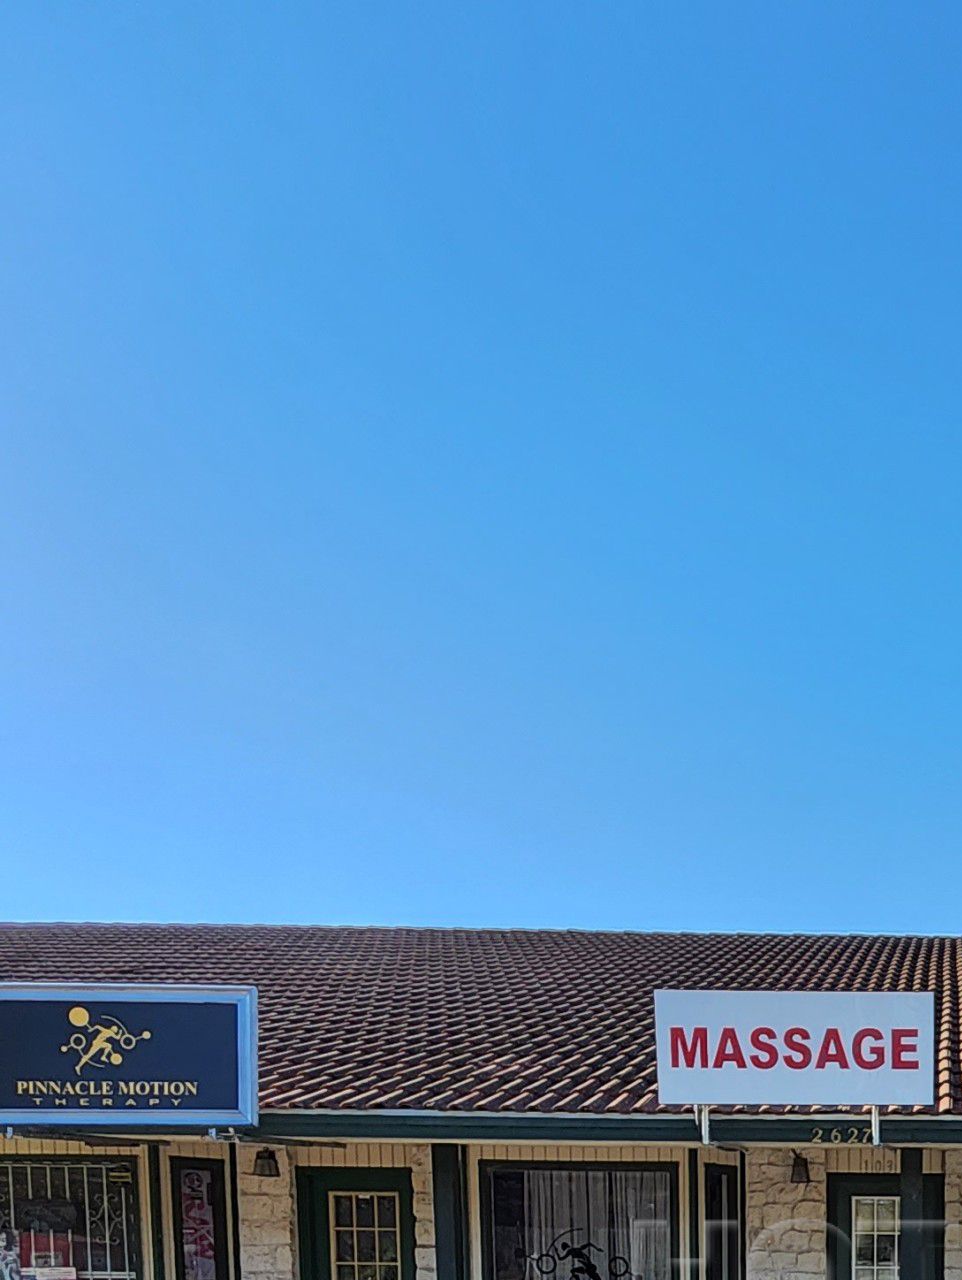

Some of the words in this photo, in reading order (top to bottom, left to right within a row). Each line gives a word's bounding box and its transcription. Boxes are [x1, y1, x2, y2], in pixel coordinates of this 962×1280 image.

[668, 1026, 920, 1071] MASSAGE
[16, 1080, 114, 1096] PINNACLE
[118, 1081, 199, 1097] MOTION
[32, 1097, 183, 1107] THERAPY
[811, 1127, 872, 1144] 2627
[863, 1160, 894, 1173] 103
